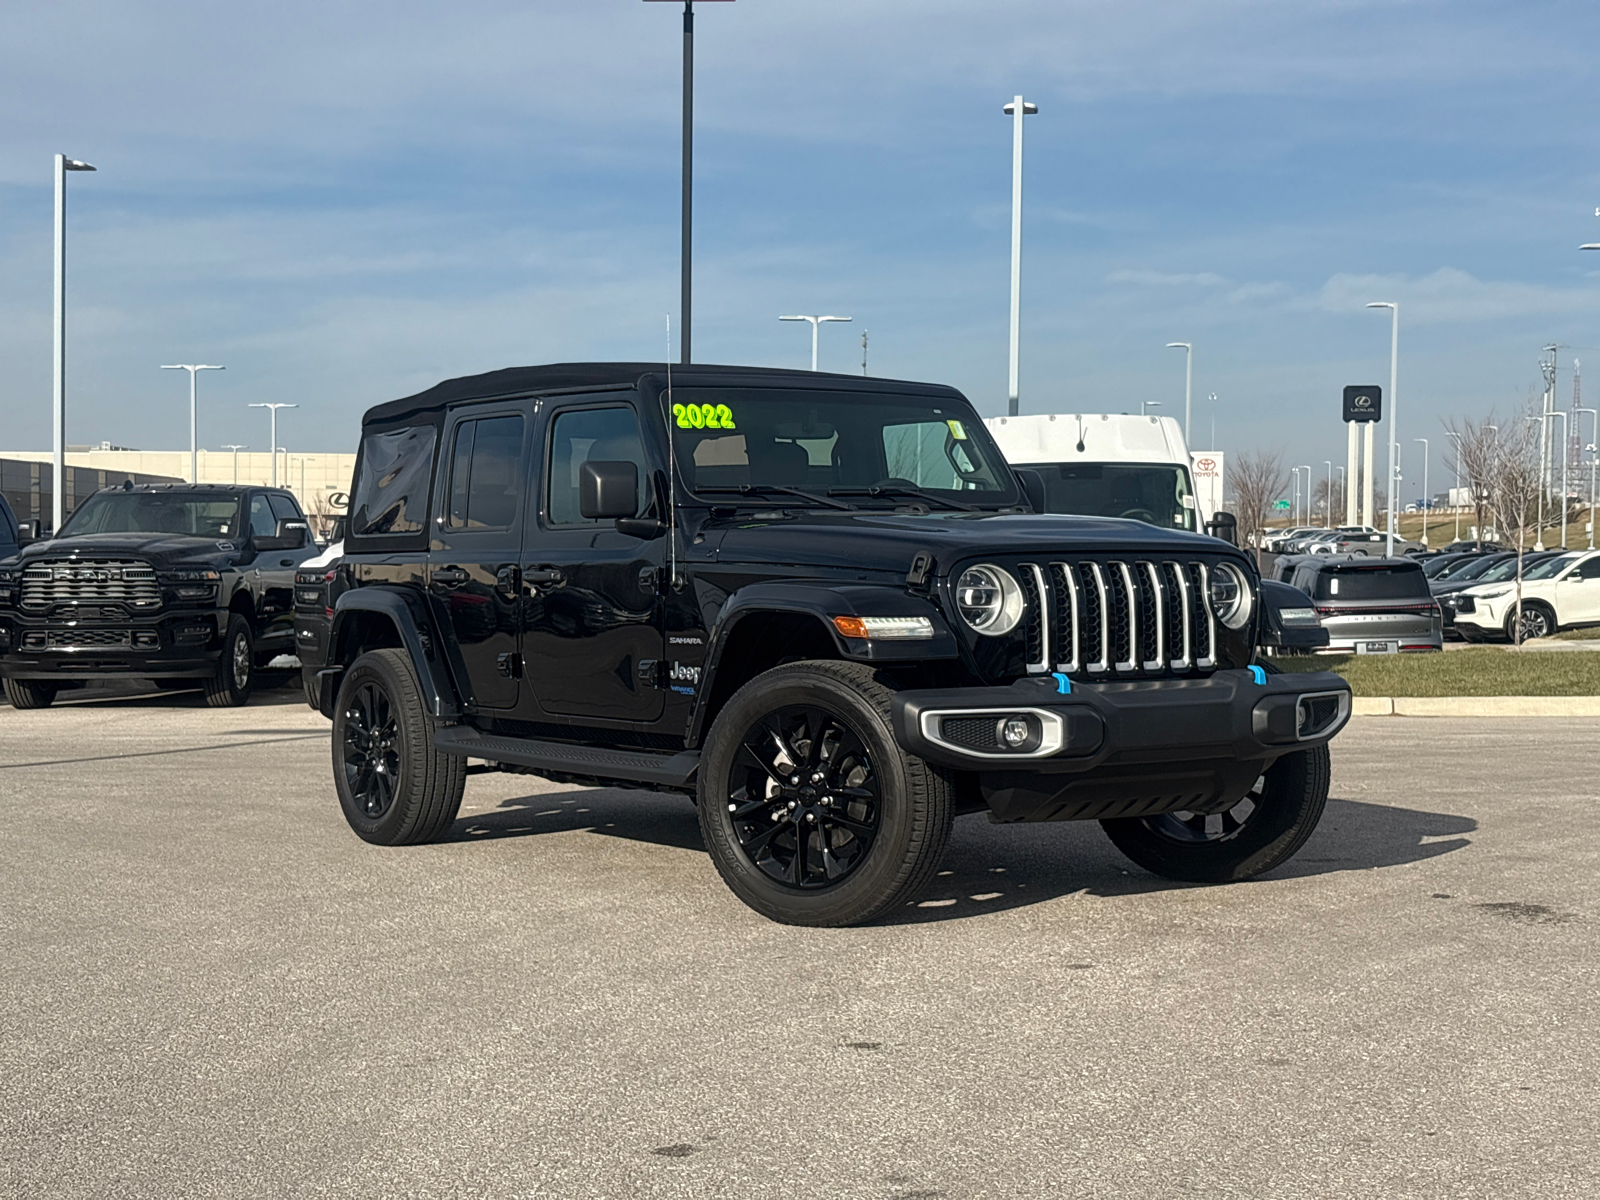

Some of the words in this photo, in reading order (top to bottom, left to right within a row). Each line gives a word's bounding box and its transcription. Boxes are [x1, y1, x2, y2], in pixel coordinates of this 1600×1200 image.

[673, 403, 736, 429] 2022
[669, 636, 703, 644] SAHARA
[670, 661, 701, 684] Jeep
[708, 723, 746, 877] BRIDGESTONE
